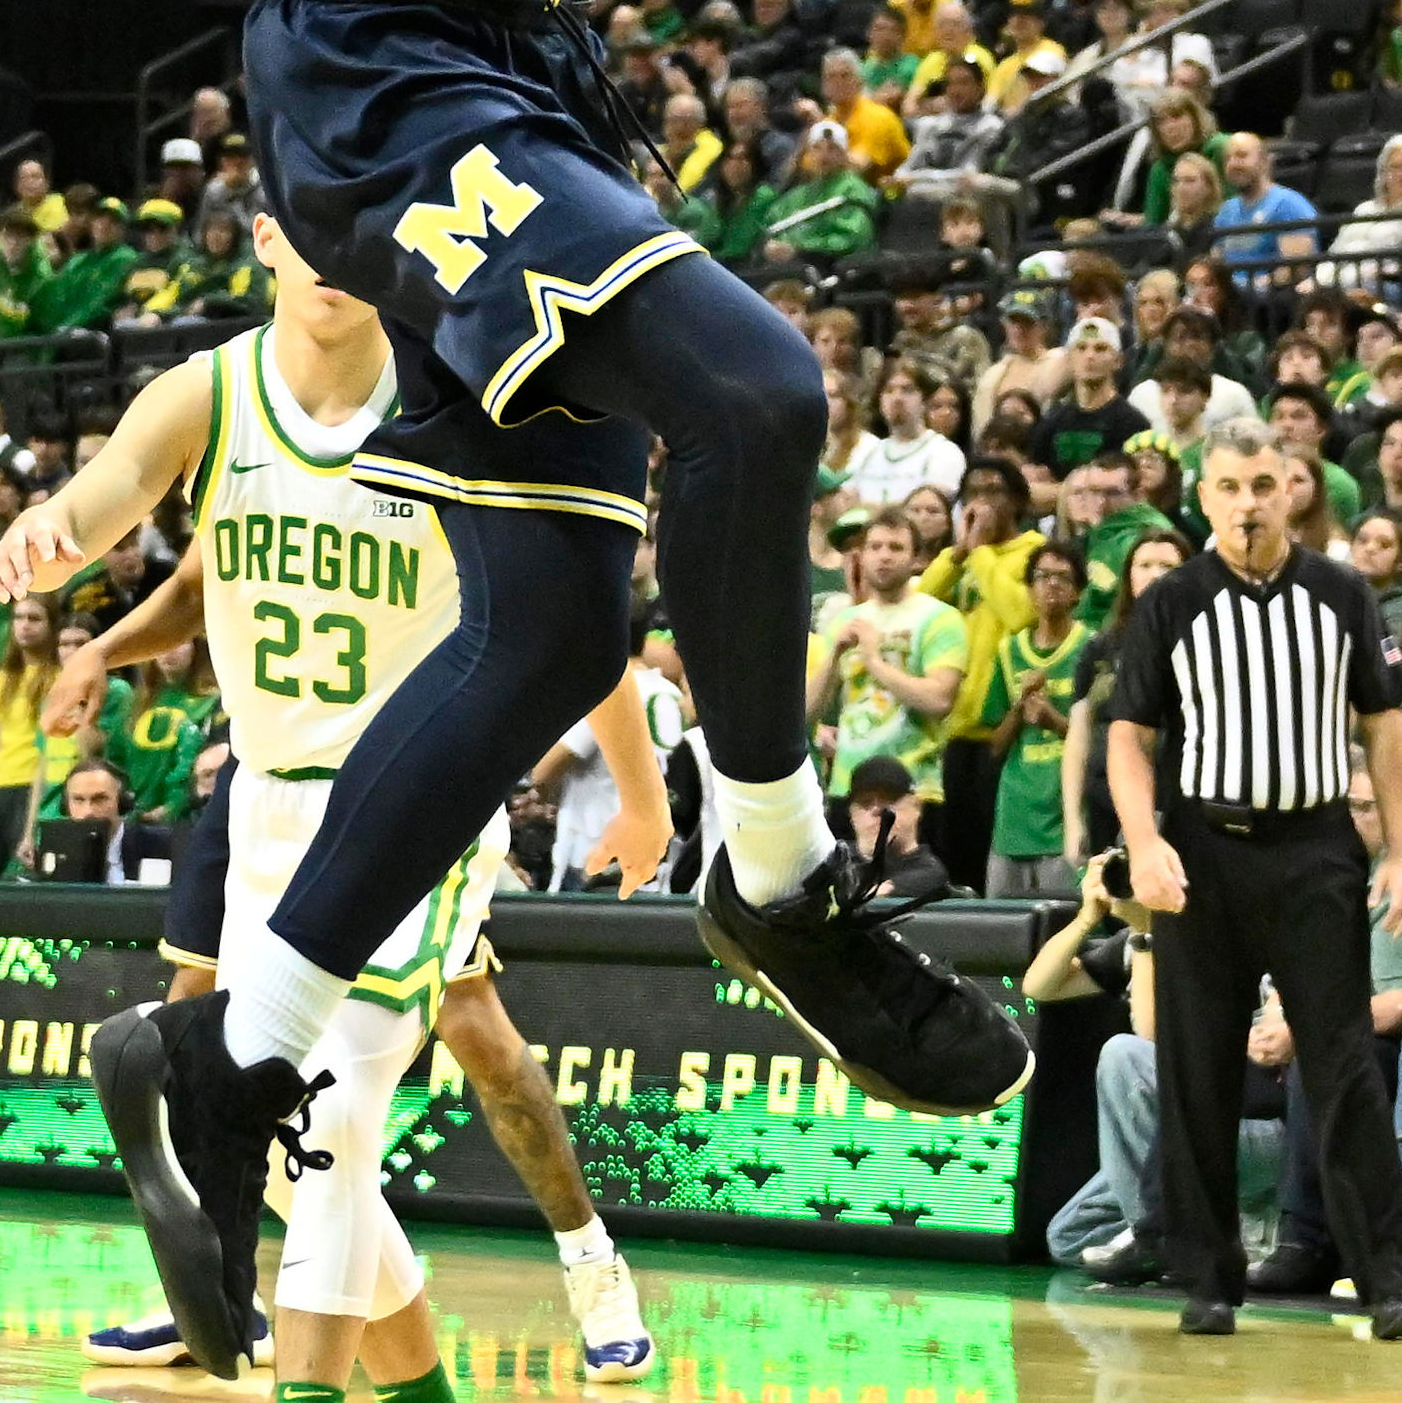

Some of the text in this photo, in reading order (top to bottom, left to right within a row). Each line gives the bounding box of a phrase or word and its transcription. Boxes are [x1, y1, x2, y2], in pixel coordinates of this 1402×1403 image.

[391, 142, 545, 296] M
[214, 513, 420, 610] OREGON
[253, 599, 367, 705] 23
[133, 706, 187, 751] O
[675, 1051, 994, 1125] SPON
